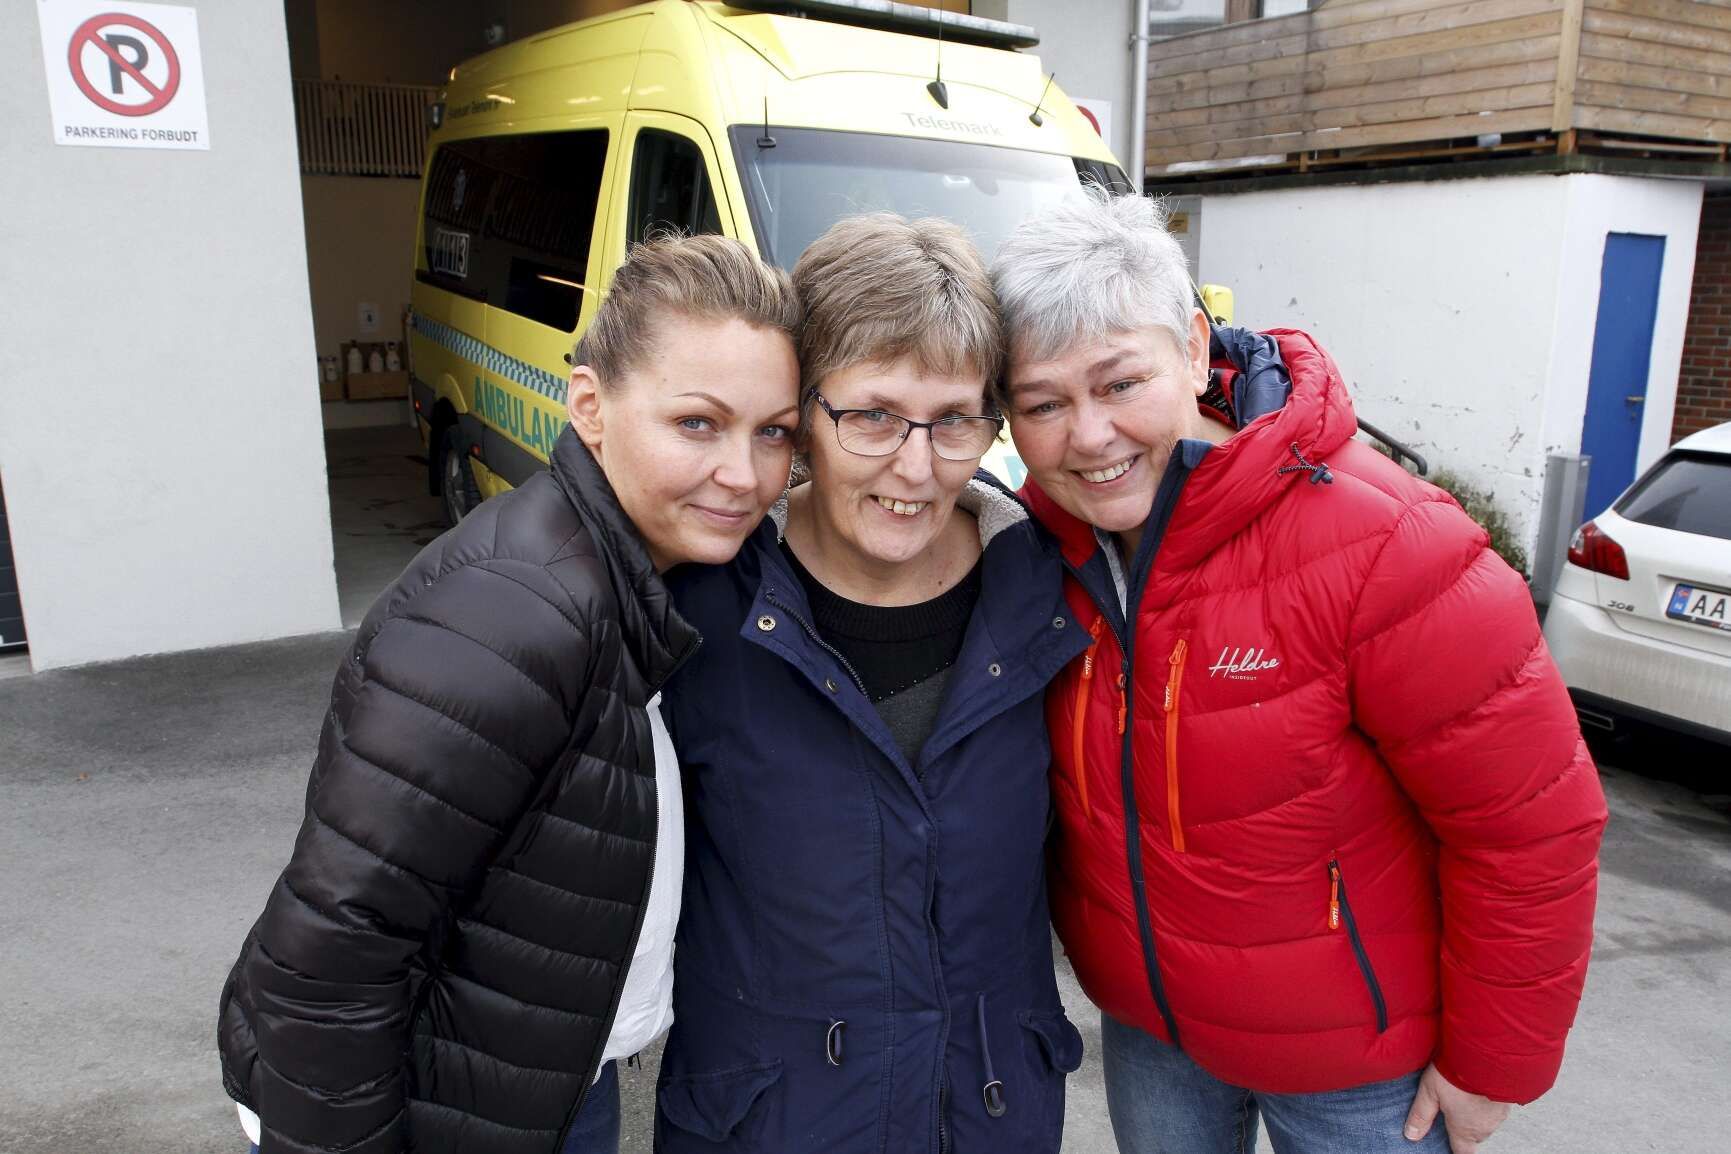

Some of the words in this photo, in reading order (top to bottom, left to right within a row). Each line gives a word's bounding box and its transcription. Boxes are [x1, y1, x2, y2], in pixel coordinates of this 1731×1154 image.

[105, 33, 149, 95] P
[64, 125, 138, 141] PARKERING
[141, 128, 199, 143] FORBUDT
[901, 112, 1004, 137] Telemark
[474, 375, 567, 456] AMBULAN
[1691, 594, 1726, 619] AA
[1208, 646, 1280, 678] Heldre
